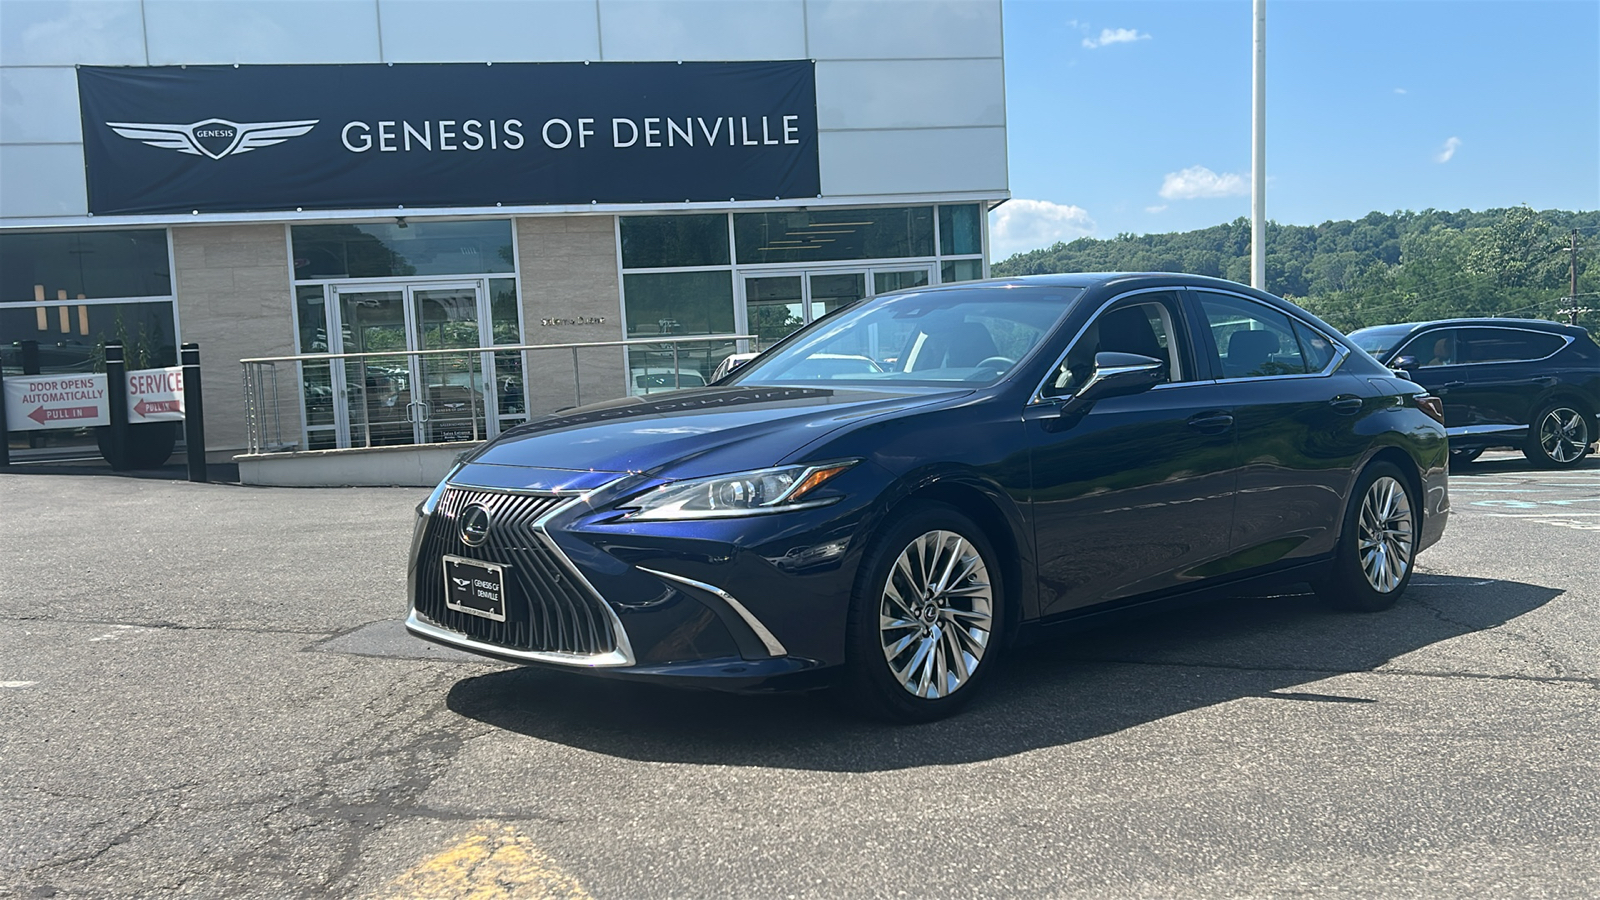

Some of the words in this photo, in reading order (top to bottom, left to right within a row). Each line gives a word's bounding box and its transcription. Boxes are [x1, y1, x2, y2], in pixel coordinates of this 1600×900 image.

[196, 128, 234, 138] GENESIS
[341, 118, 525, 153] GENESIS
[541, 117, 595, 149] OF
[612, 115, 800, 148] DENVILLE
[29, 381, 58, 392] DOOR
[60, 378, 94, 390] OPENS
[129, 372, 183, 395] SERVICE
[22, 389, 104, 404] AUTOMATICALLY
[46, 410, 70, 419] PULL
[73, 409, 83, 417] IN
[145, 403, 163, 412] PULL
[474, 578, 493, 590] GENESIS
[492, 583, 500, 591] OF
[477, 589, 499, 601] DENVILLE
